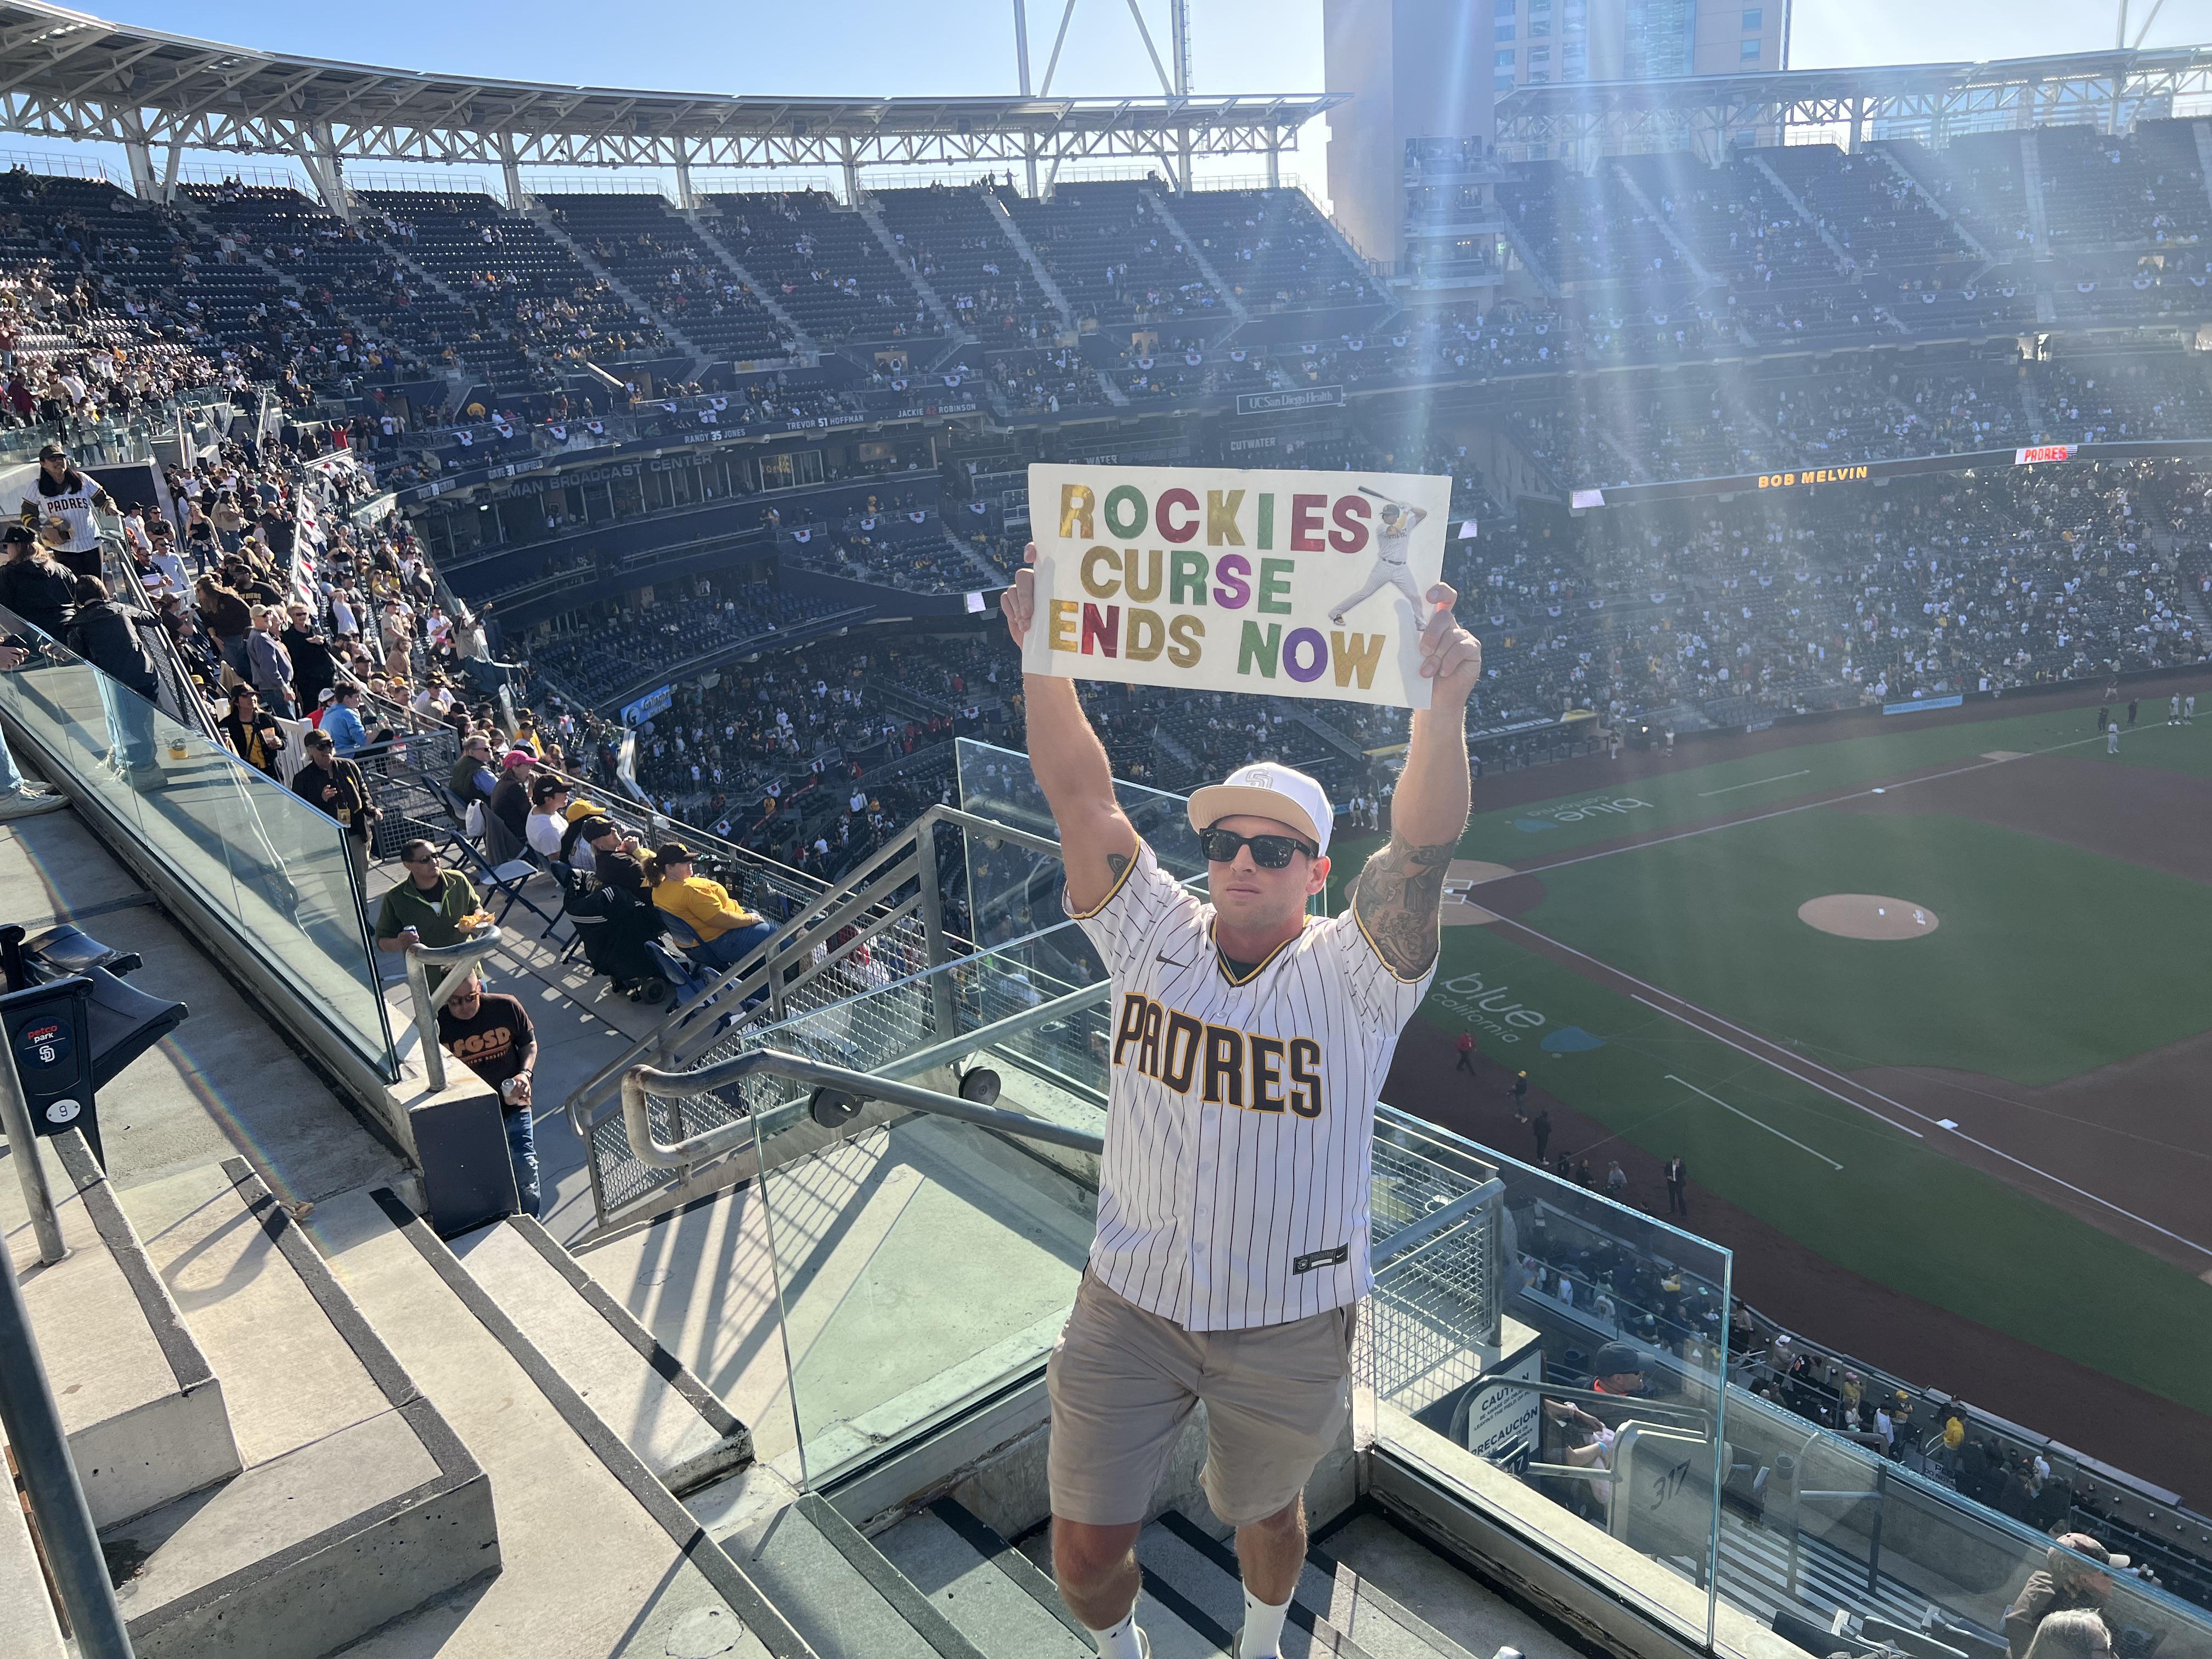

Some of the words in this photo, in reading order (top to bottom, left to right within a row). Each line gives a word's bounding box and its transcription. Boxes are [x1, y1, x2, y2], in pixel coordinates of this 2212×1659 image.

[1249, 397, 1264, 409] UC
[1264, 396, 1280, 407] San
[1282, 394, 1305, 407] Diego
[1306, 391, 1333, 403] Health
[898, 408, 924, 418] JACKIE
[926, 407, 937, 416] 42
[938, 403, 976, 414] ROBINSON
[786, 419, 816, 431] TREVOR
[817, 417, 828, 427] 51
[830, 415, 864, 426] HOFFMAN
[684, 433, 709, 444] RANDY
[710, 430, 722, 441] 35
[724, 428, 746, 439] JONES
[1231, 437, 1277, 450] CUTWATER
[2024, 446, 2068, 462] PADRES
[505, 465, 516, 477] 31
[549, 463, 642, 489] BROADCAST
[650, 453, 712, 472] CENTER
[1758, 473, 1795, 488] BOB
[1801, 466, 1867, 484] MELVIN
[47, 498, 88, 514] PADRES
[1059, 484, 1372, 554] ROCKIES
[1080, 546, 1295, 615] CURSE
[1048, 599, 1206, 669] ENDS
[1238, 620, 1386, 690] NOW
[1554, 797, 1654, 822] blue
[1440, 973, 1545, 1028] blue
[1431, 993, 1521, 1043] california
[28, 1025, 58, 1040] petco
[34, 1032, 54, 1043] park
[39, 1045, 55, 1063] SD
[1113, 992, 1323, 1119] PADRES
[59, 1105, 68, 1117] 9
[1474, 1414, 1494, 1431] LEAVING
[1494, 1408, 1503, 1417] THE
[1504, 1399, 1517, 1410] FIELD
[1471, 1406, 1538, 1455] PRECAUCIÓN
[1924, 1468, 1934, 1476] DO
[1650, 1458, 1691, 1510] 317
